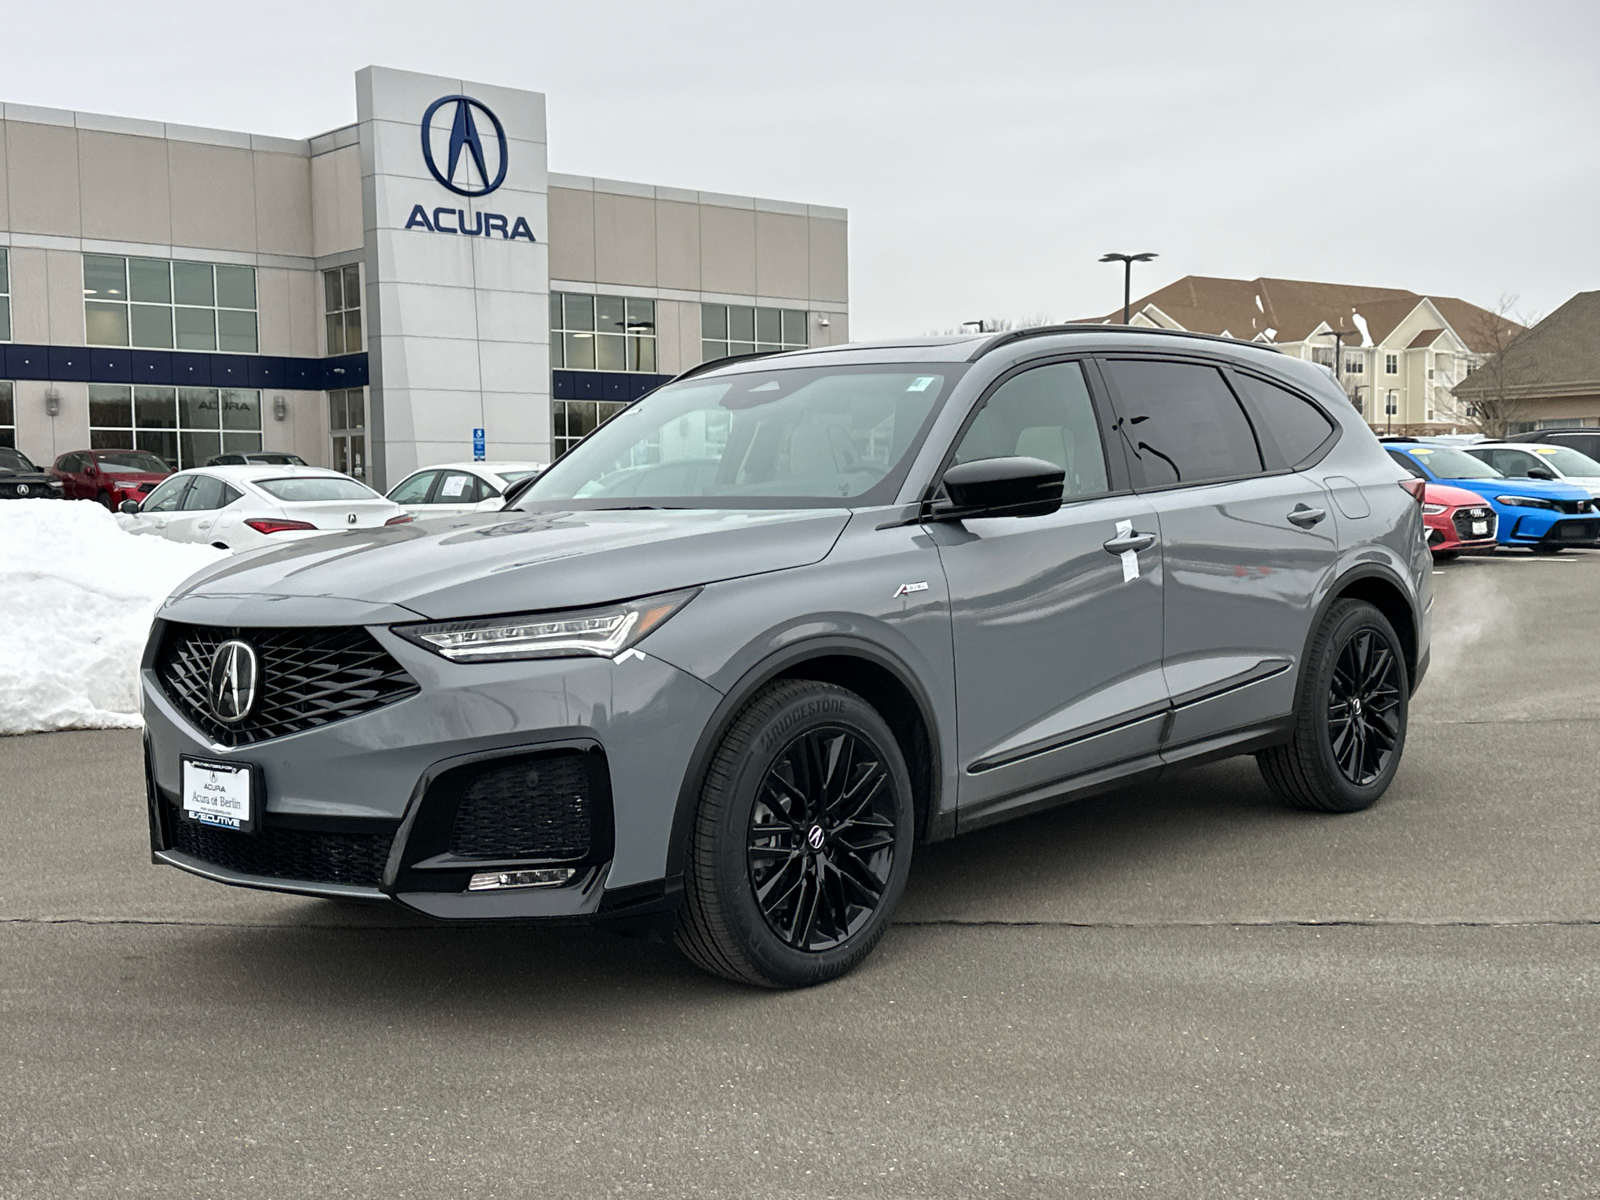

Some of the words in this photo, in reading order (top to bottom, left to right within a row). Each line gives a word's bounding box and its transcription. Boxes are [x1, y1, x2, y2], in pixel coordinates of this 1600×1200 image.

[405, 204, 536, 242] ACURA
[760, 698, 846, 752] BRIDGESTONE
[204, 783, 226, 792] ACURA
[192, 791, 210, 805] Acura
[220, 796, 241, 810] Berlin
[188, 811, 240, 827] EXECUTIVE
